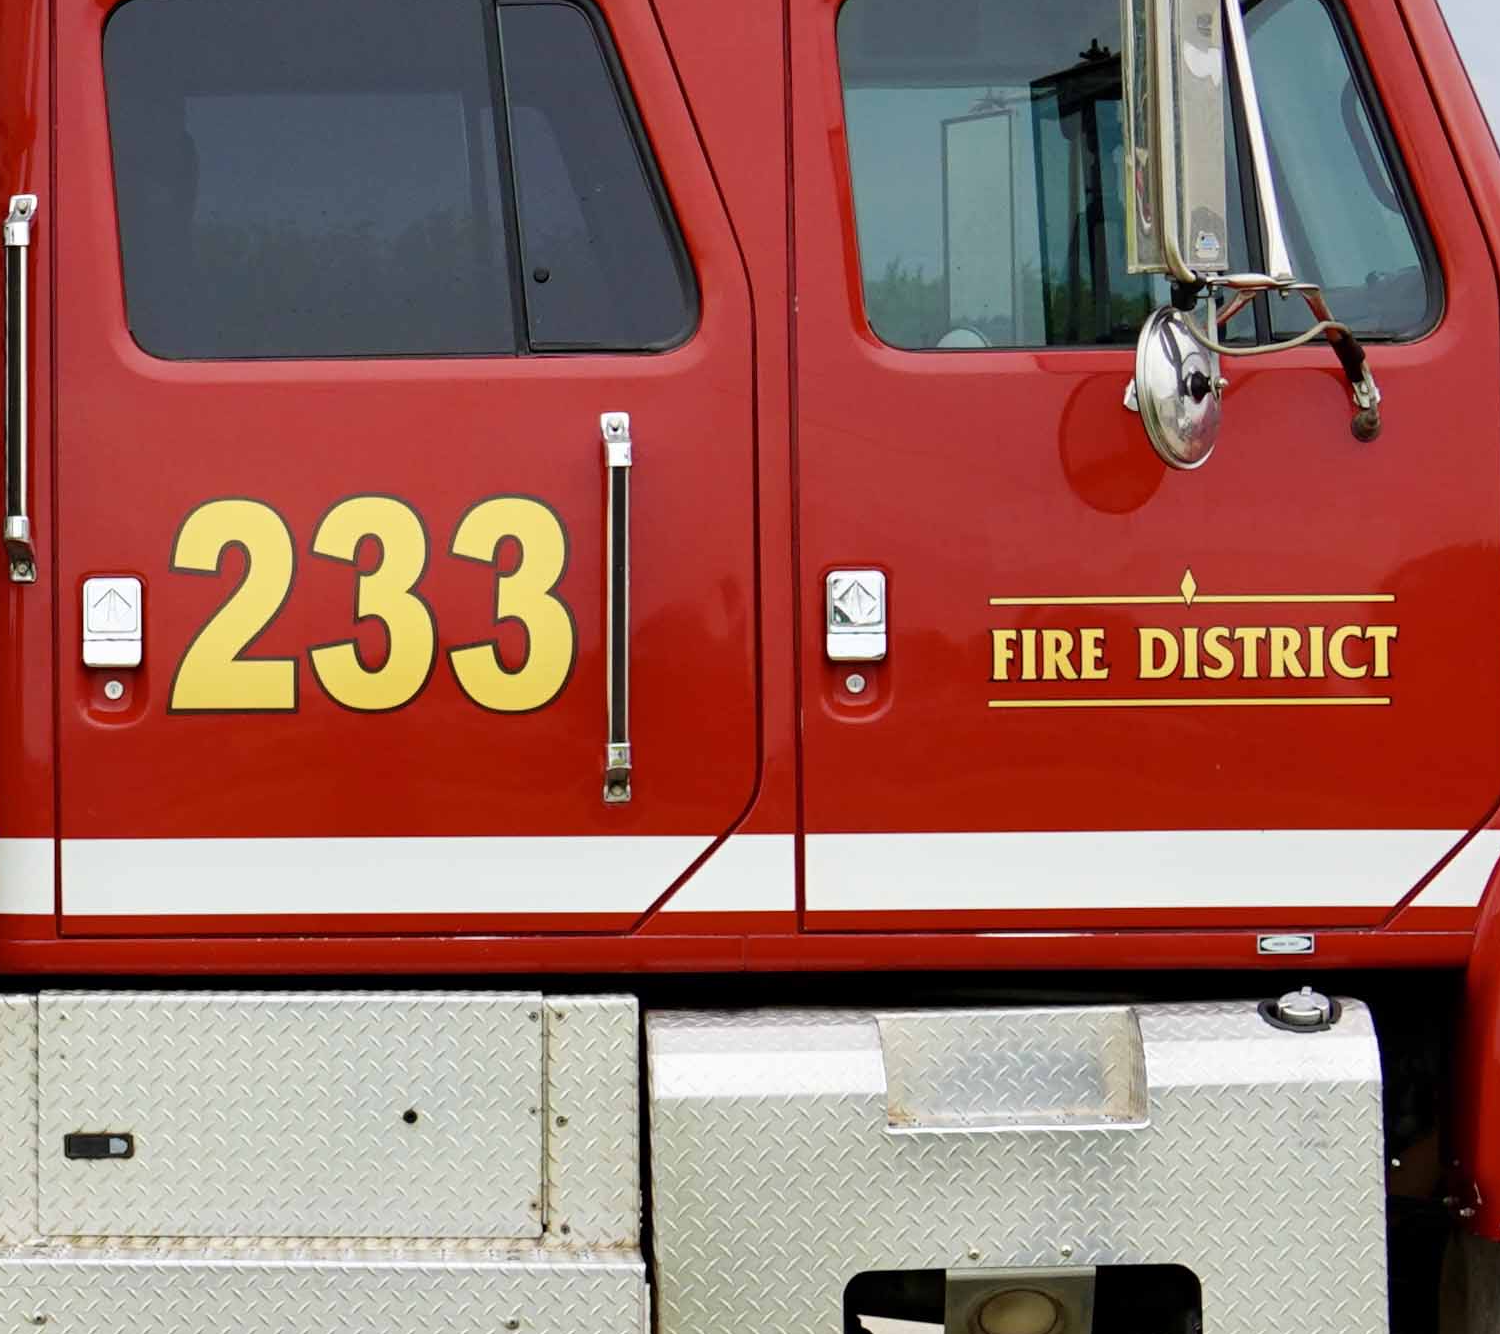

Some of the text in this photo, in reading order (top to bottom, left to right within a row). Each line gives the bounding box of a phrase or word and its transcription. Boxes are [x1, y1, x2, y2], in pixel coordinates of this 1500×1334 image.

[166, 495, 577, 715] 233
[990, 624, 1398, 683] FIRE DISTRICT
